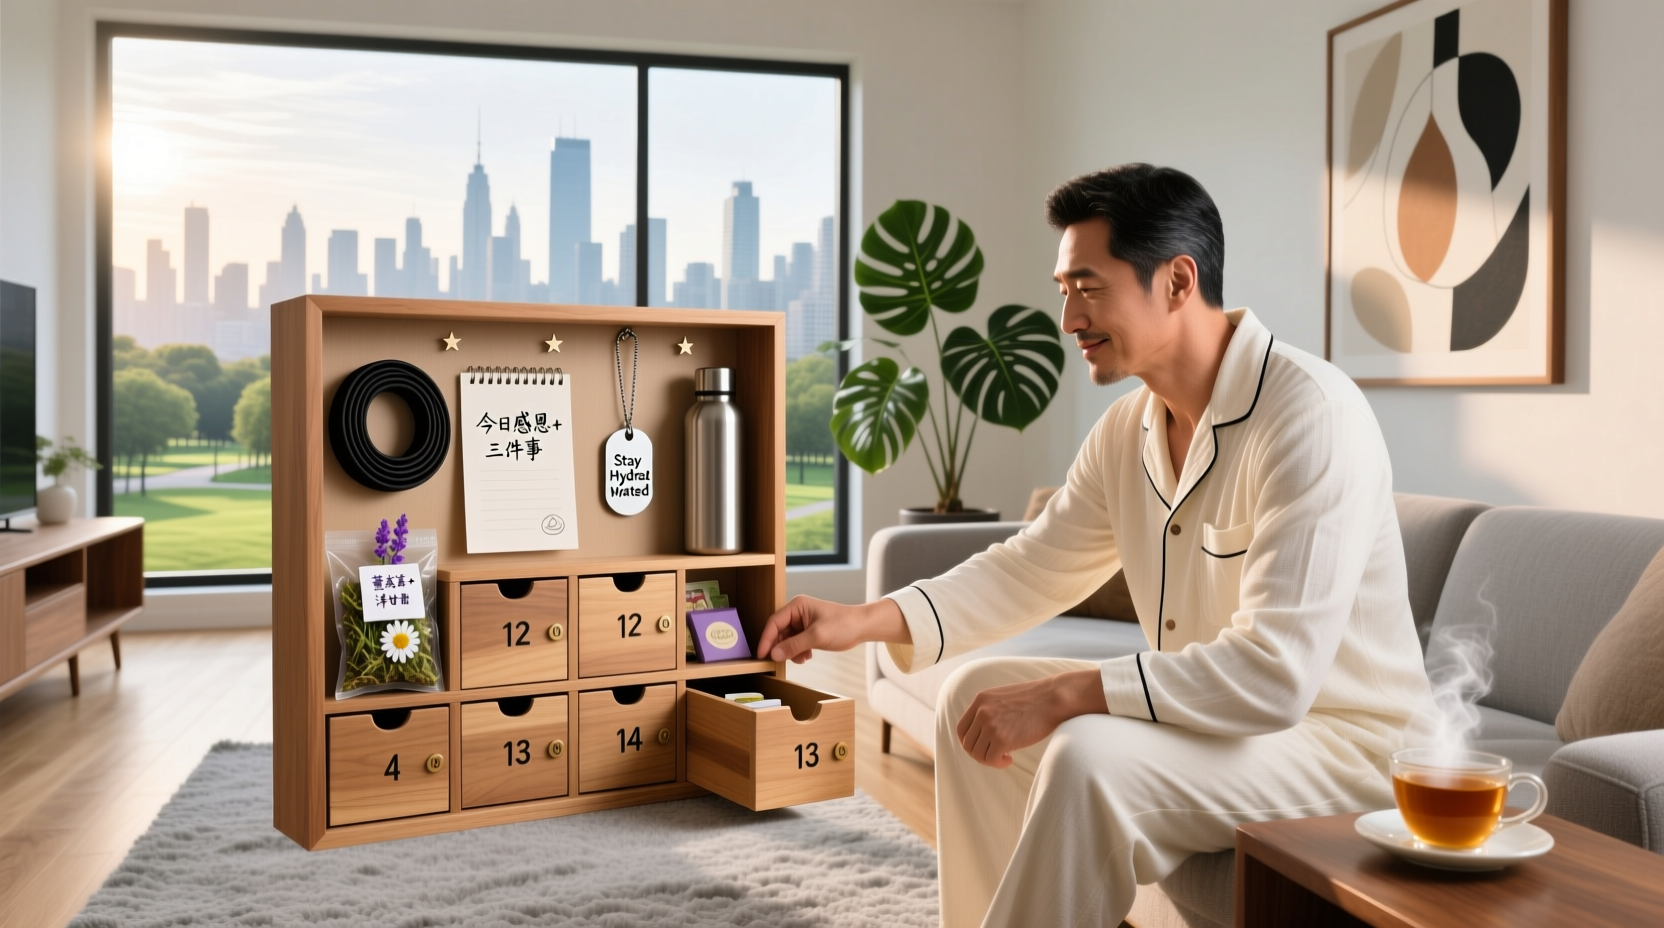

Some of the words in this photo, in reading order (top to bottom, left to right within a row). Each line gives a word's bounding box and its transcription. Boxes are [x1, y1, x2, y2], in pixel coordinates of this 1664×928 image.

[476, 411, 562, 434] 今日感恩+
[485, 436, 543, 461] 三件事
[614, 453, 642, 469] Stay
[502, 620, 531, 648] 12
[617, 612, 642, 639] 12
[503, 739, 531, 767] 13
[616, 726, 643, 753] 14
[383, 753, 400, 782] 4
[794, 742, 820, 770] 13
